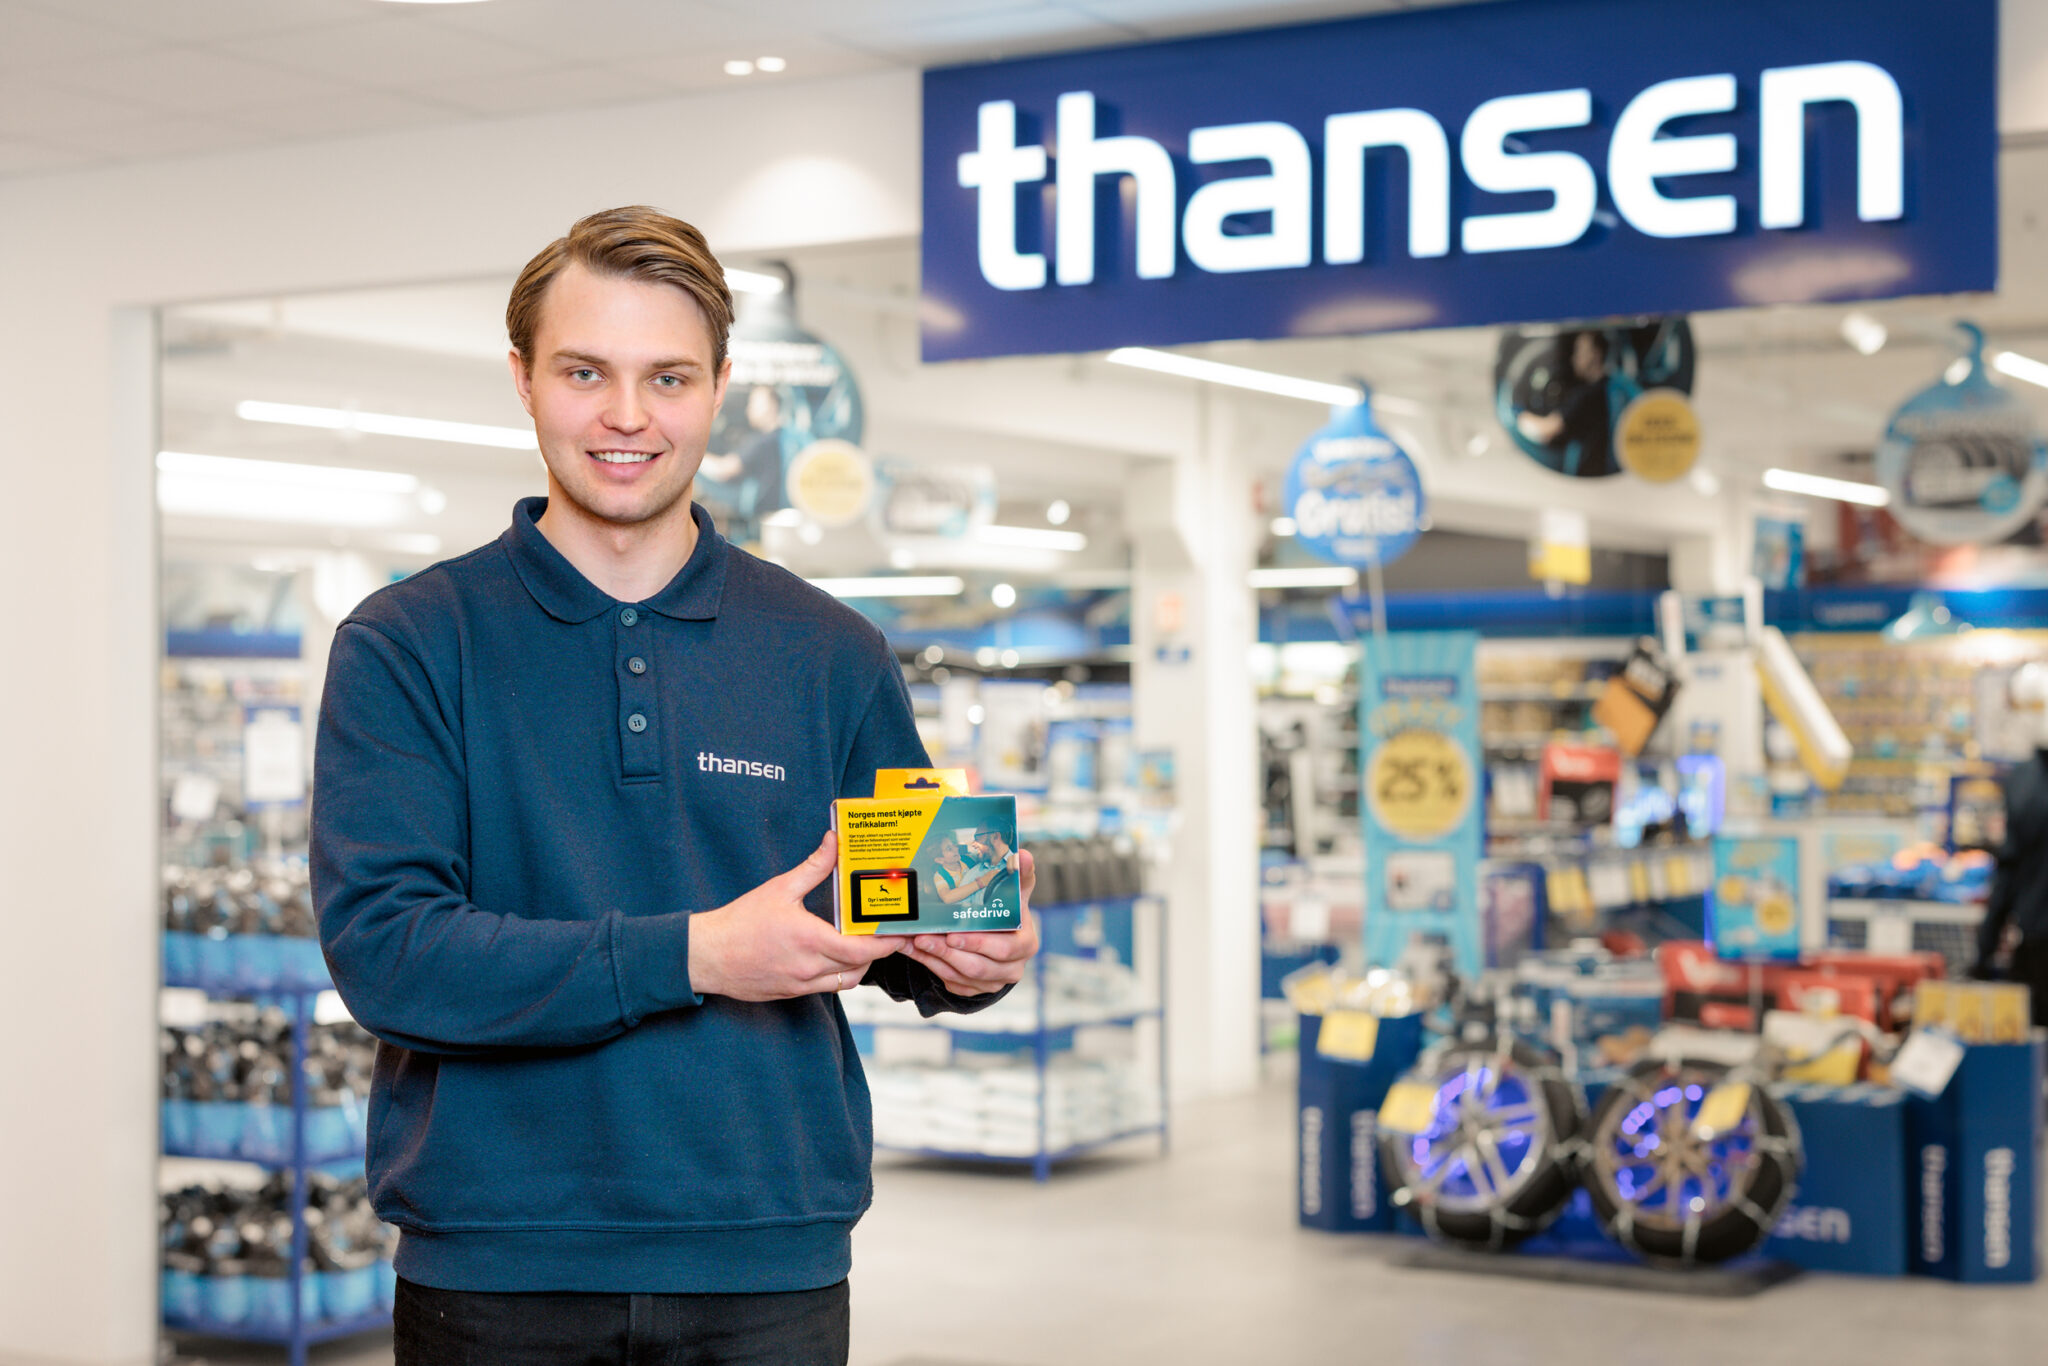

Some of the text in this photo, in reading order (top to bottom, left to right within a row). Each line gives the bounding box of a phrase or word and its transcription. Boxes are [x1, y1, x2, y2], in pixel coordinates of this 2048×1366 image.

[957, 59, 1905, 291] thansen
[697, 752, 785, 781] thansen
[848, 809, 922, 820] Norges mest kjøpte
[848, 820, 898, 829] trafikkalarm!
[953, 907, 1010, 919] safedrive
